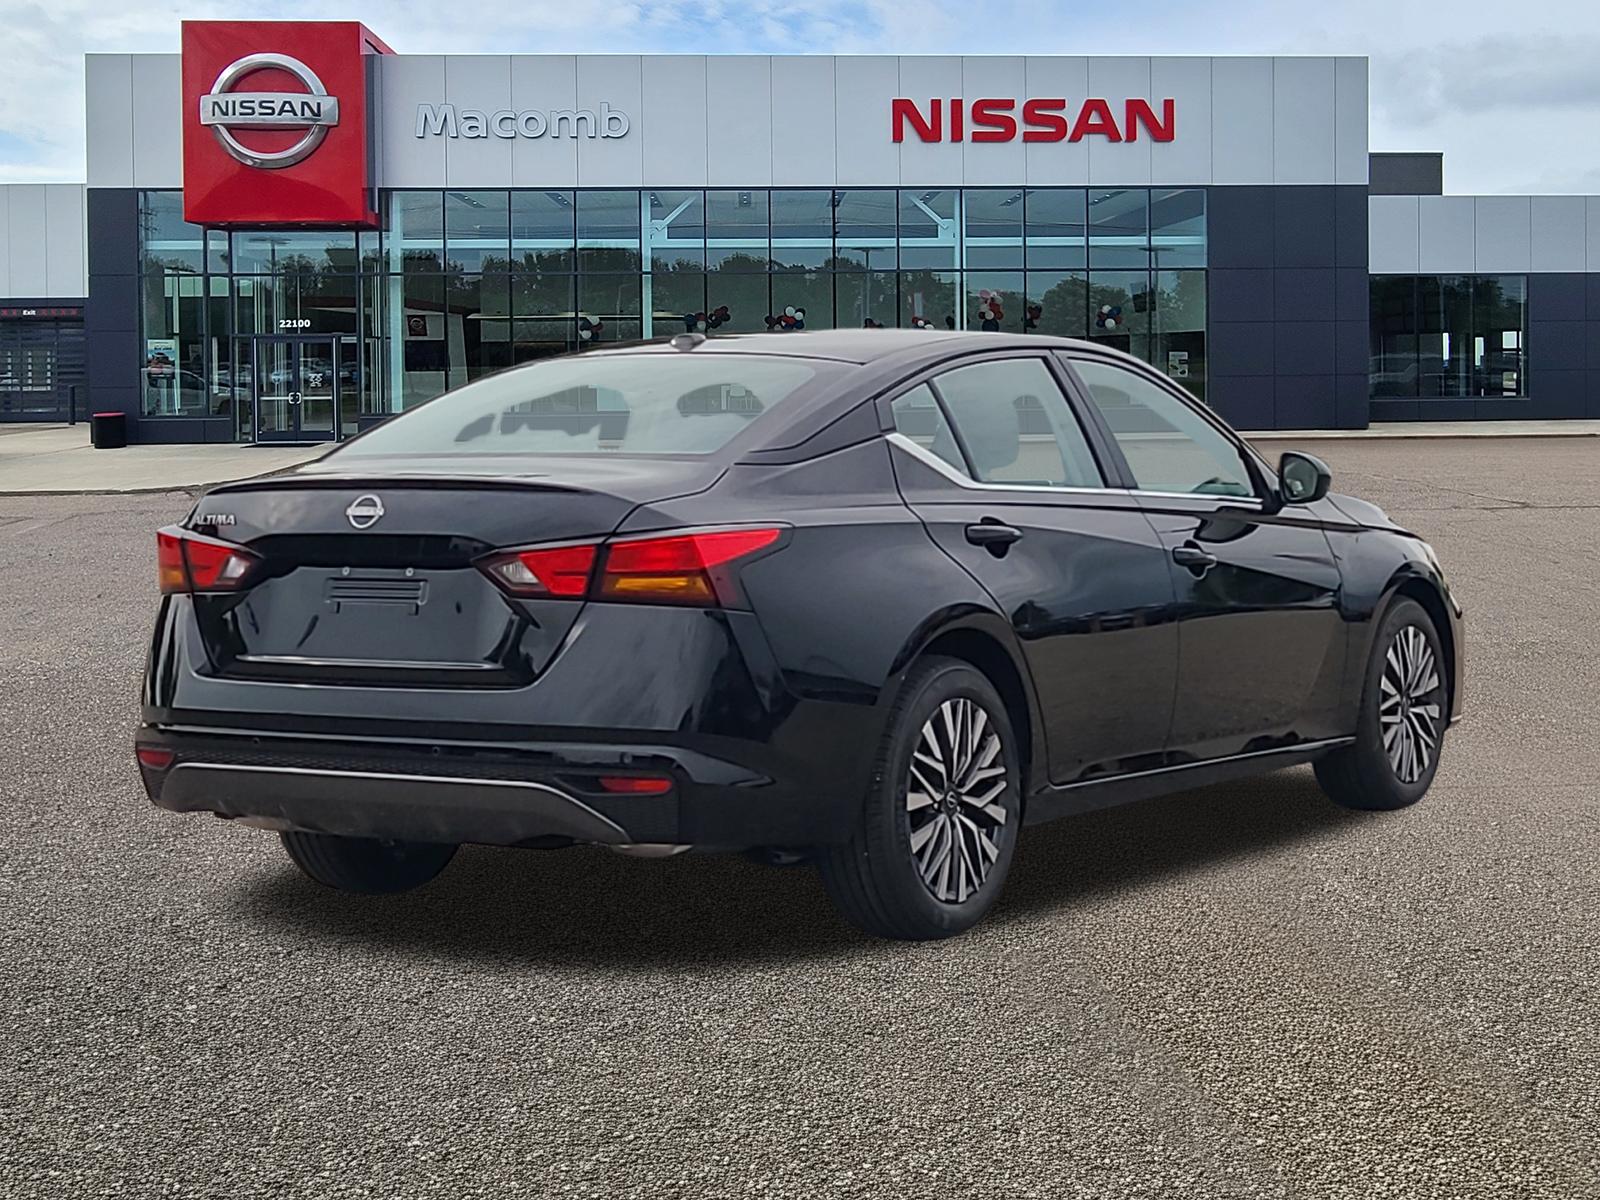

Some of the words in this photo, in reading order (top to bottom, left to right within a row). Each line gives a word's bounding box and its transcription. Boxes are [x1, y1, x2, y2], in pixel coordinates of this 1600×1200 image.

[211, 100, 322, 117] NISSAN
[415, 101, 630, 138] Macomb
[892, 98, 1175, 143] NISSAN
[279, 319, 311, 328] 22100
[192, 513, 235, 525] ALTIMA
